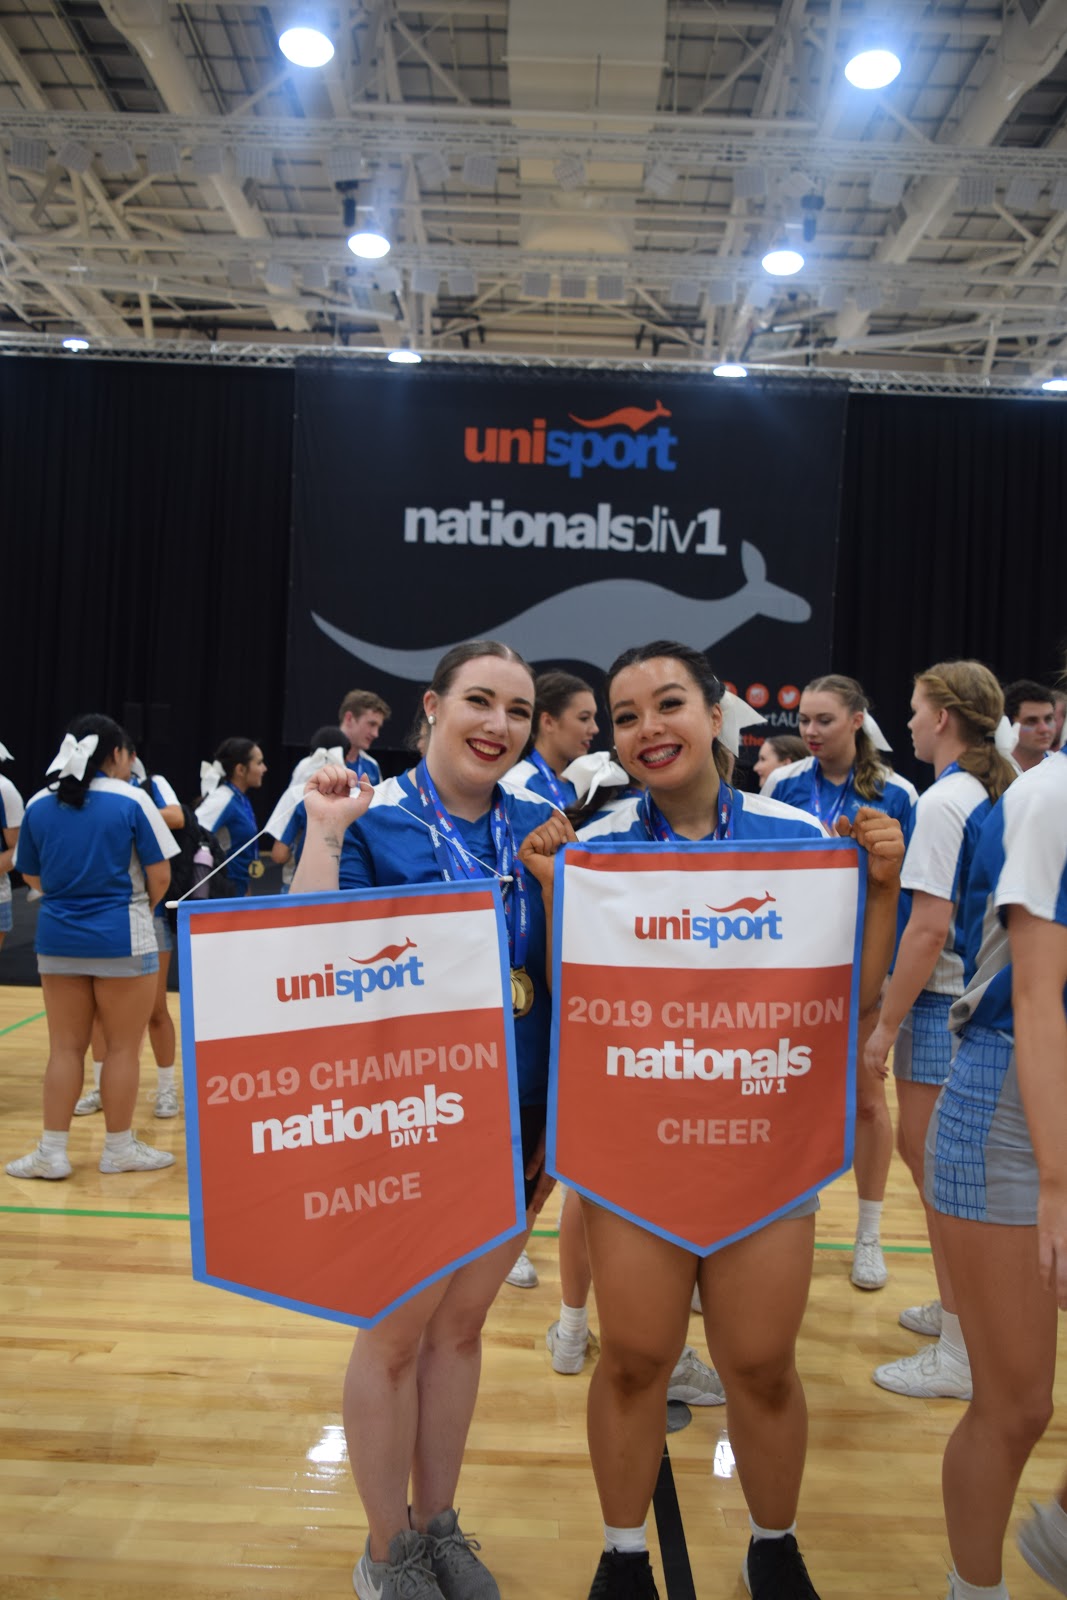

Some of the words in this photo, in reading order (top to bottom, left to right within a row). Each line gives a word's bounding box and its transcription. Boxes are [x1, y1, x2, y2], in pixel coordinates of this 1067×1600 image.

[464, 418, 678, 478] unisport
[634, 909, 783, 949] unisport
[276, 955, 425, 1003] unisport
[567, 996, 653, 1028] 2019
[661, 996, 845, 1030] CHAMPION
[206, 1066, 301, 1106] 2019
[309, 1041, 499, 1091] CHAMPION
[606, 1037, 812, 1080] nationals
[741, 1079, 774, 1096] DIV
[777, 1078, 788, 1094] 1
[251, 1084, 465, 1154] nationals
[390, 1129, 423, 1149] DIV
[426, 1126, 439, 1144] 1
[657, 1118, 771, 1146] CHEER
[303, 1171, 422, 1221] DANCE
